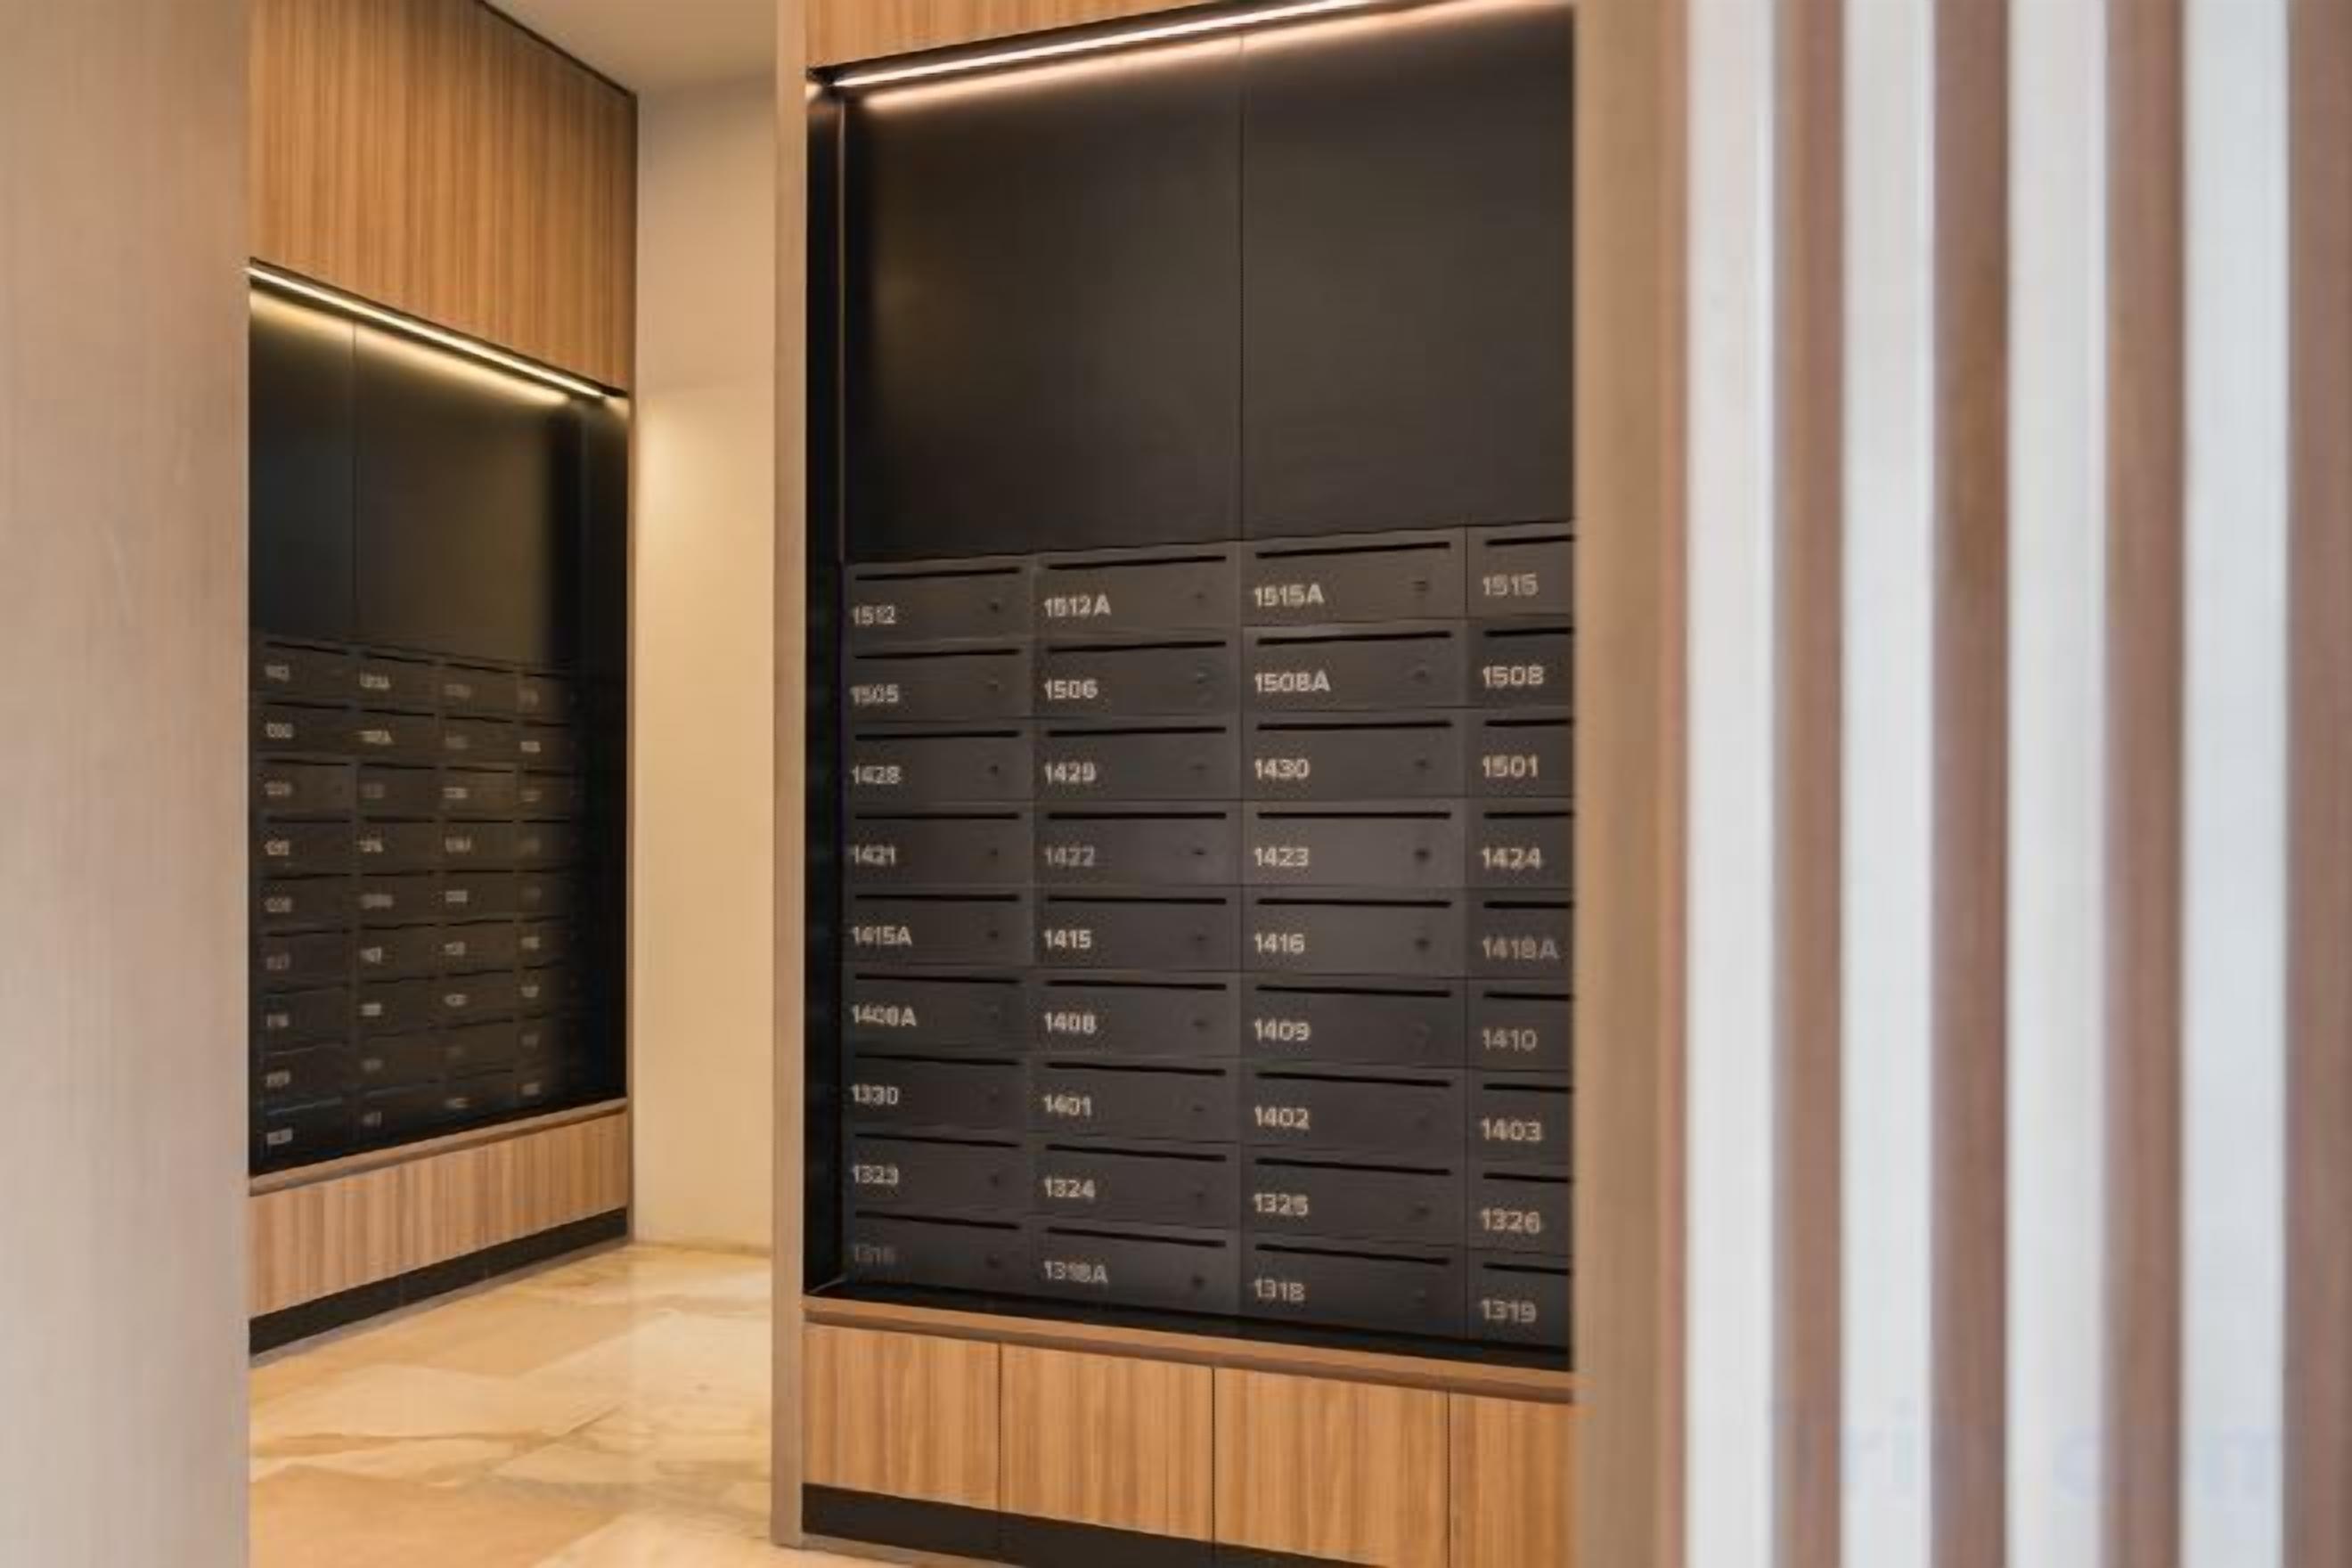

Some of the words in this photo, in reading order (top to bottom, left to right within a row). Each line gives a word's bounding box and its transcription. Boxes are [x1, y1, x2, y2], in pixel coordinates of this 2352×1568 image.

[1254, 584, 1324, 606] 1515A
[1483, 574, 1539, 596] 1515
[1254, 671, 1331, 692] 1508A
[1483, 666, 1544, 688] 1508
[1044, 680, 1098, 700] 1506
[1044, 762, 1097, 782] 1429
[1254, 758, 1311, 780] 1430
[1482, 755, 1539, 777] 1501
[1044, 846, 1095, 867] 1422
[1254, 847, 1309, 867] 1423
[1482, 847, 1541, 869] 1424
[1044, 929, 1092, 950] 1415
[1254, 933, 1305, 954] 1416
[1254, 1019, 1311, 1041] 1409
[1482, 1029, 1538, 1051] 1410
[1254, 1107, 1311, 1129] 1402
[1482, 1117, 1542, 1141] 1403
[1044, 1178, 1096, 1200] 1324
[1254, 1193, 1309, 1216] 1325
[1482, 1210, 1540, 1234] 1326
[1254, 1279, 1305, 1302] 1318
[1482, 1299, 1537, 1323] 1319
